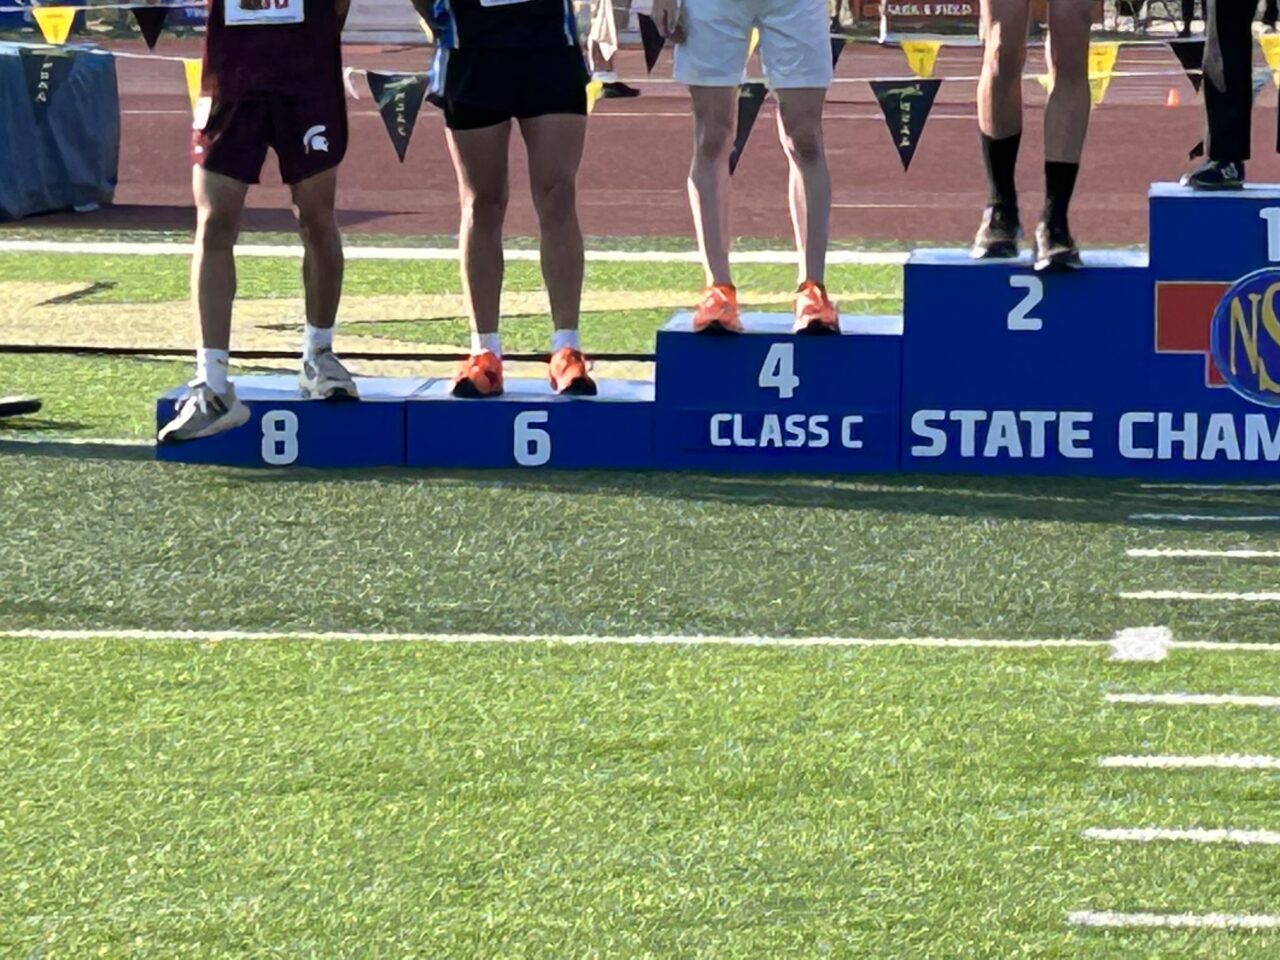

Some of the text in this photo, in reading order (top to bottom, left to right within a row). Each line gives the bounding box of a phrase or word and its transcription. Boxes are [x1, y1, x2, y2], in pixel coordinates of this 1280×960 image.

[1007, 276, 1043, 331] 2
[758, 343, 799, 398] 4
[260, 410, 299, 465] 8
[513, 410, 551, 466] 6
[709, 413, 864, 448] CLASS C
[911, 409, 1094, 458] STATE
